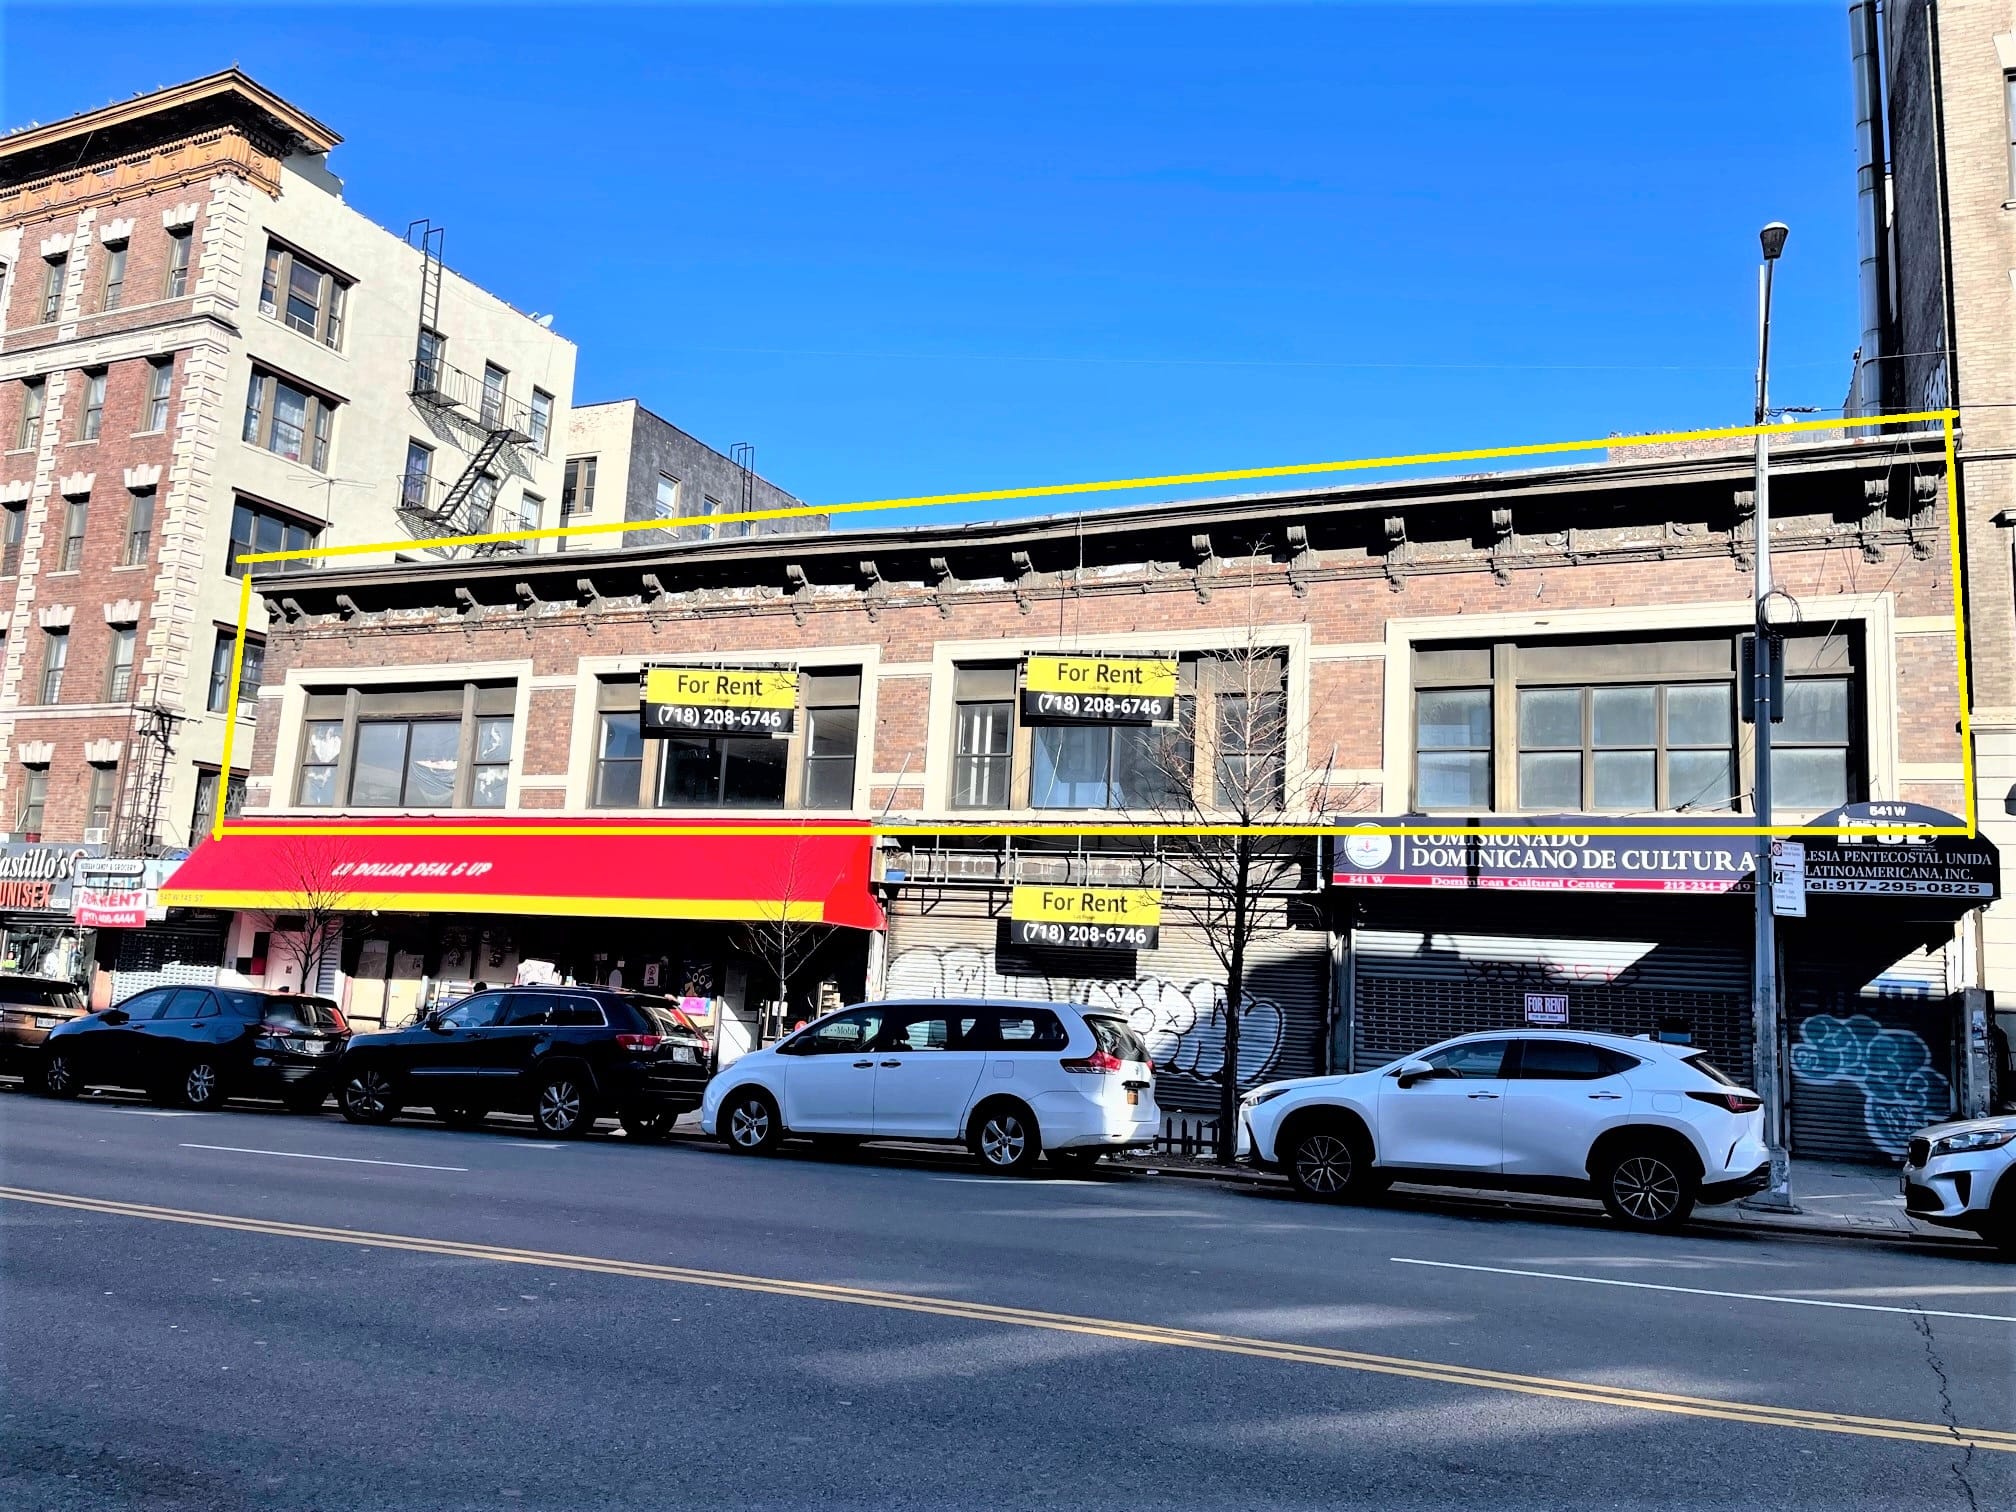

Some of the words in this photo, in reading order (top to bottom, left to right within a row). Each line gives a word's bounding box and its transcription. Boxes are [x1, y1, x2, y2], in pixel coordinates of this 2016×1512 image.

[1058, 663, 1089, 682] For
[1096, 664, 1143, 684] Rent
[678, 674, 709, 693] For
[716, 675, 763, 696] Rent
[1038, 693, 1080, 714] (718)
[1084, 696, 1162, 715] 208-6746
[658, 705, 700, 726] (718)
[703, 708, 782, 727] 208-6746
[1869, 805, 1892, 817] 541
[1894, 805, 1906, 817] W
[1412, 834, 1590, 848] COMISIONADO
[0, 848, 69, 878] astillo's
[1411, 849, 1578, 869] DOMINICANO
[1582, 850, 1617, 870] DE
[1621, 850, 1757, 872] CULTURA
[1804, 850, 1840, 862] LESIA
[1844, 851, 1943, 864] PENTECOSTAL
[1946, 853, 1992, 866] UNIDA
[352, 862, 413, 877] DOLLAR
[410, 862, 454, 877] DEAL
[466, 861, 493, 877] UP
[1945, 868, 1974, 880] INC.
[1371, 876, 1385, 885] W
[1431, 876, 1506, 888] Dominican
[1507, 878, 1563, 889] Cultural
[1567, 879, 1616, 890] Center
[0, 881, 50, 908] UNISEX
[99, 893, 142, 907] RENT
[1042, 891, 1075, 911] For
[1081, 893, 1128, 913] Rent
[1023, 922, 1065, 943] (718)
[1068, 926, 1147, 944] 208-6746
[1528, 997, 1543, 1012] FOR
[1545, 998, 1565, 1013] RENT
